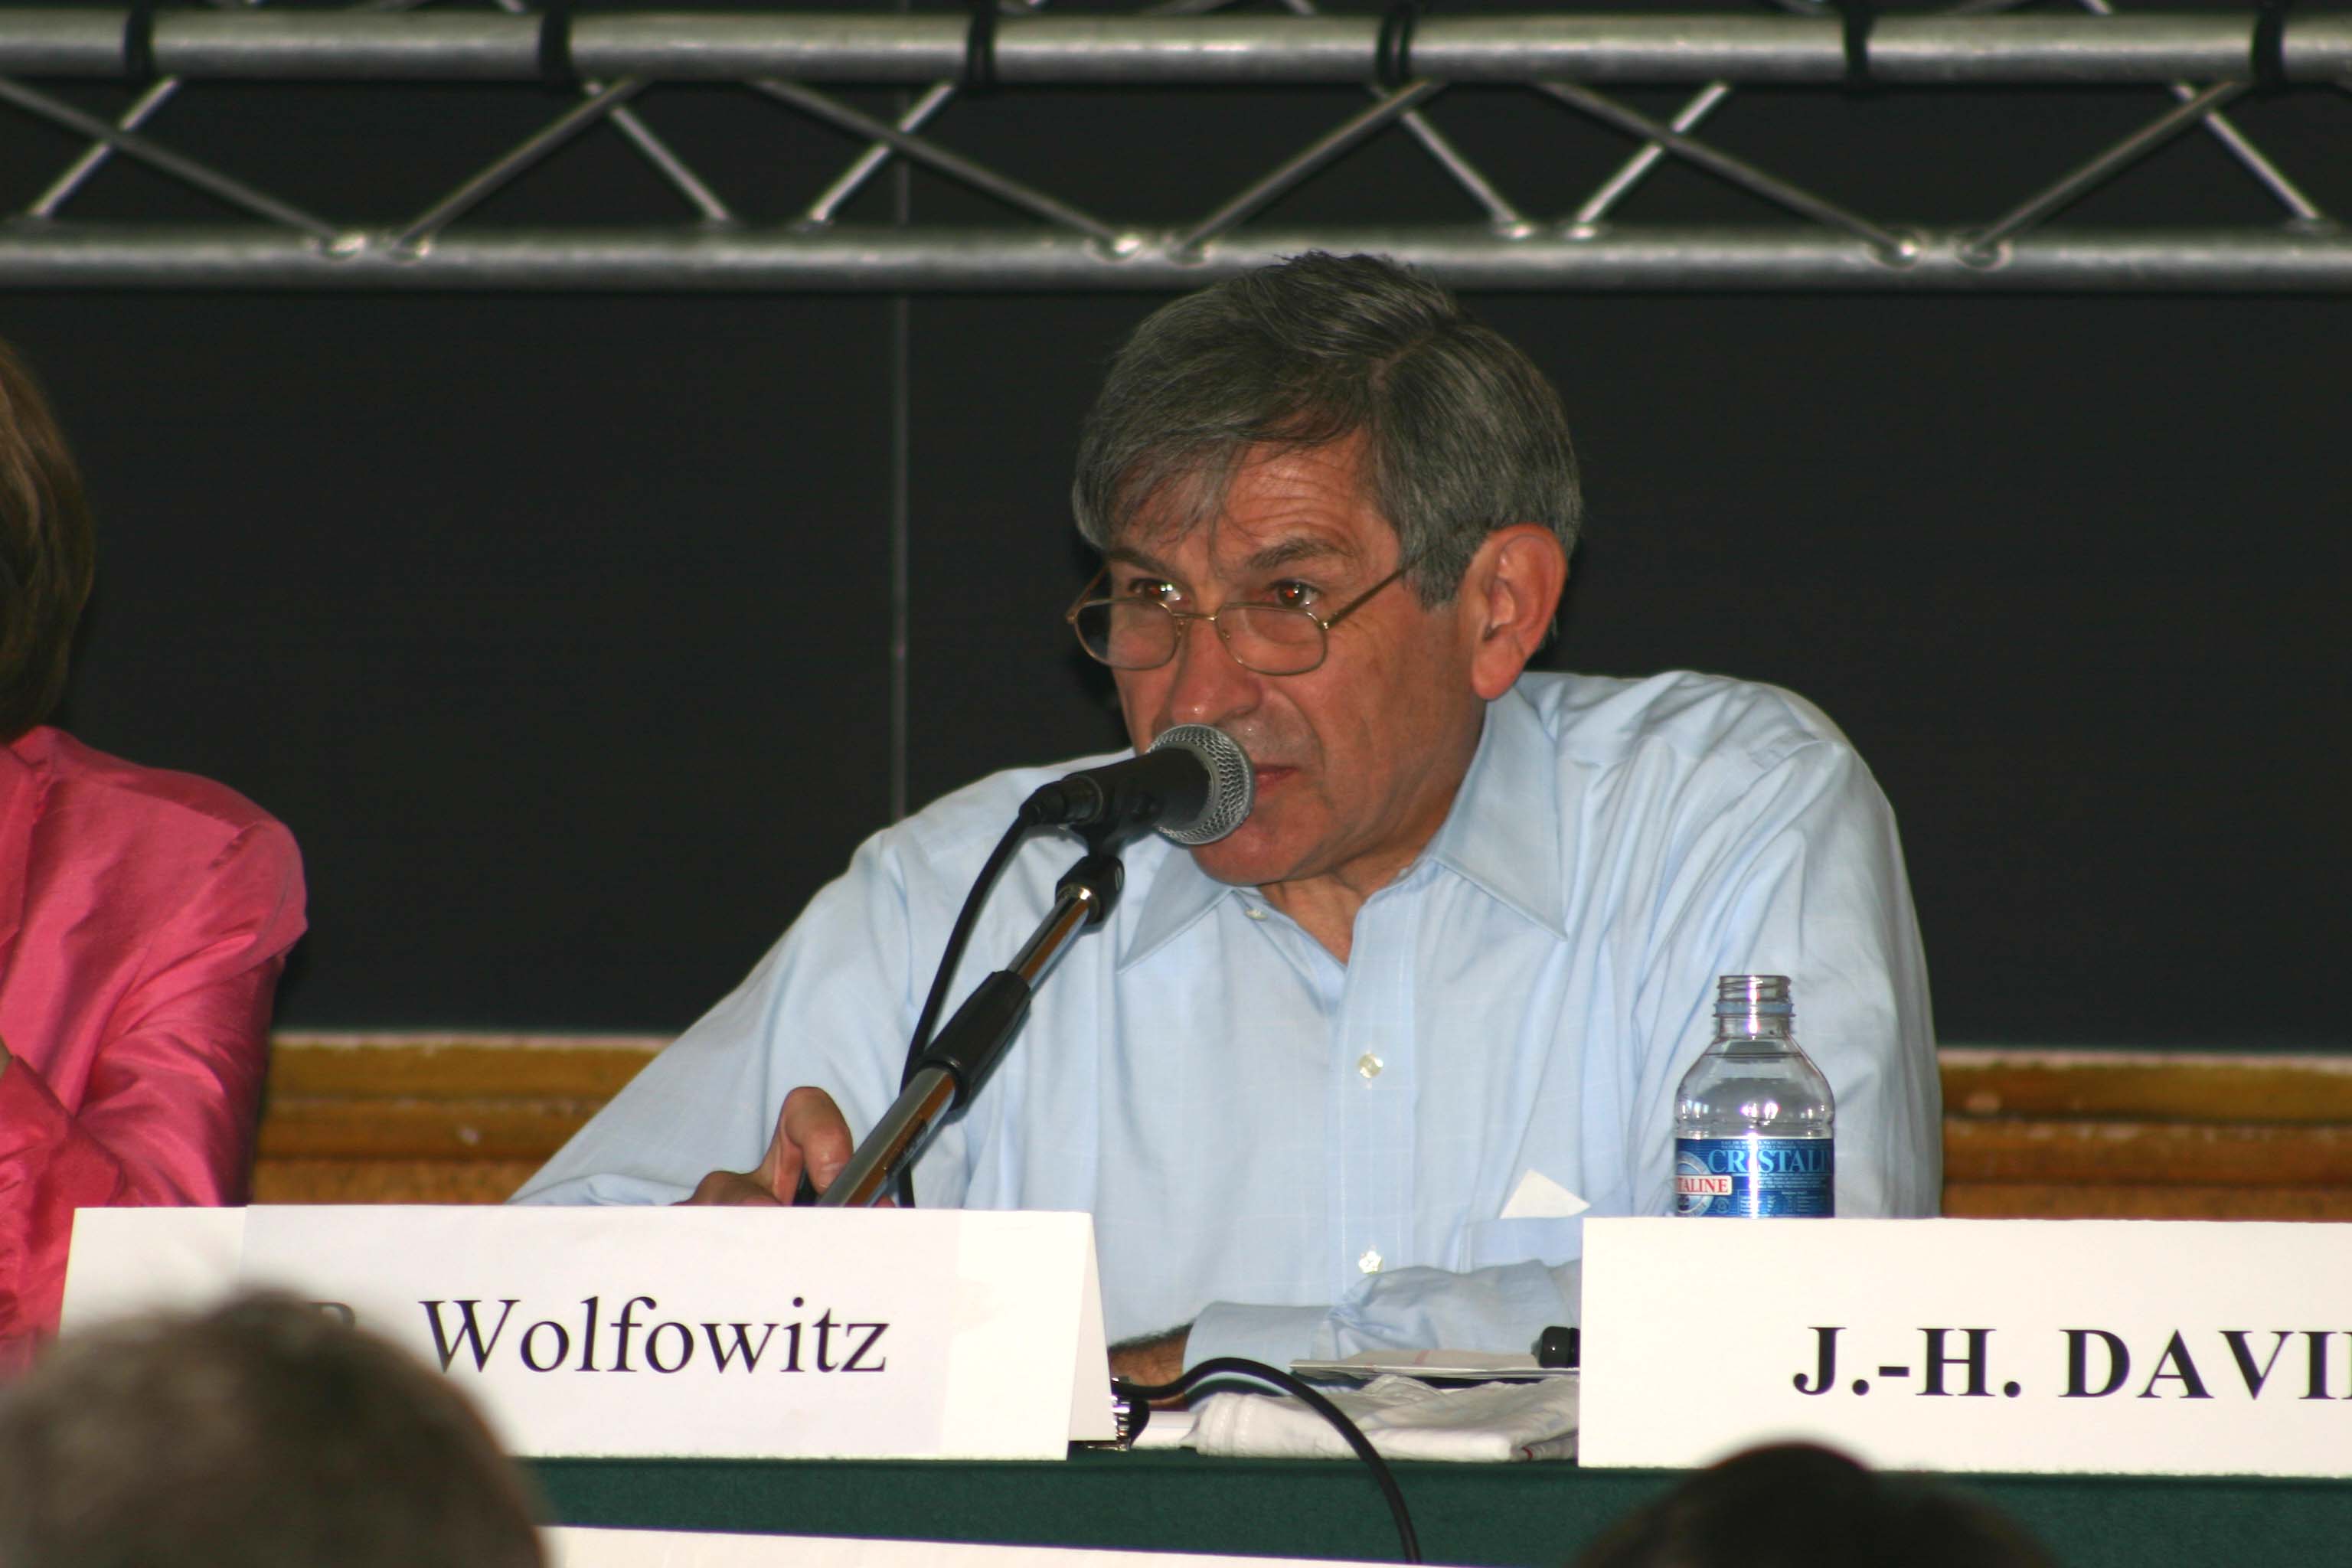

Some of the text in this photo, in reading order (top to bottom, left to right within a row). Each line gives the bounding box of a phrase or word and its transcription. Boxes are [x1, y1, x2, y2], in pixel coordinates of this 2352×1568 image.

[417, 1295, 890, 1374] Wolfowitz
[1792, 1327, 2352, 1400] J.-H. DAVI
